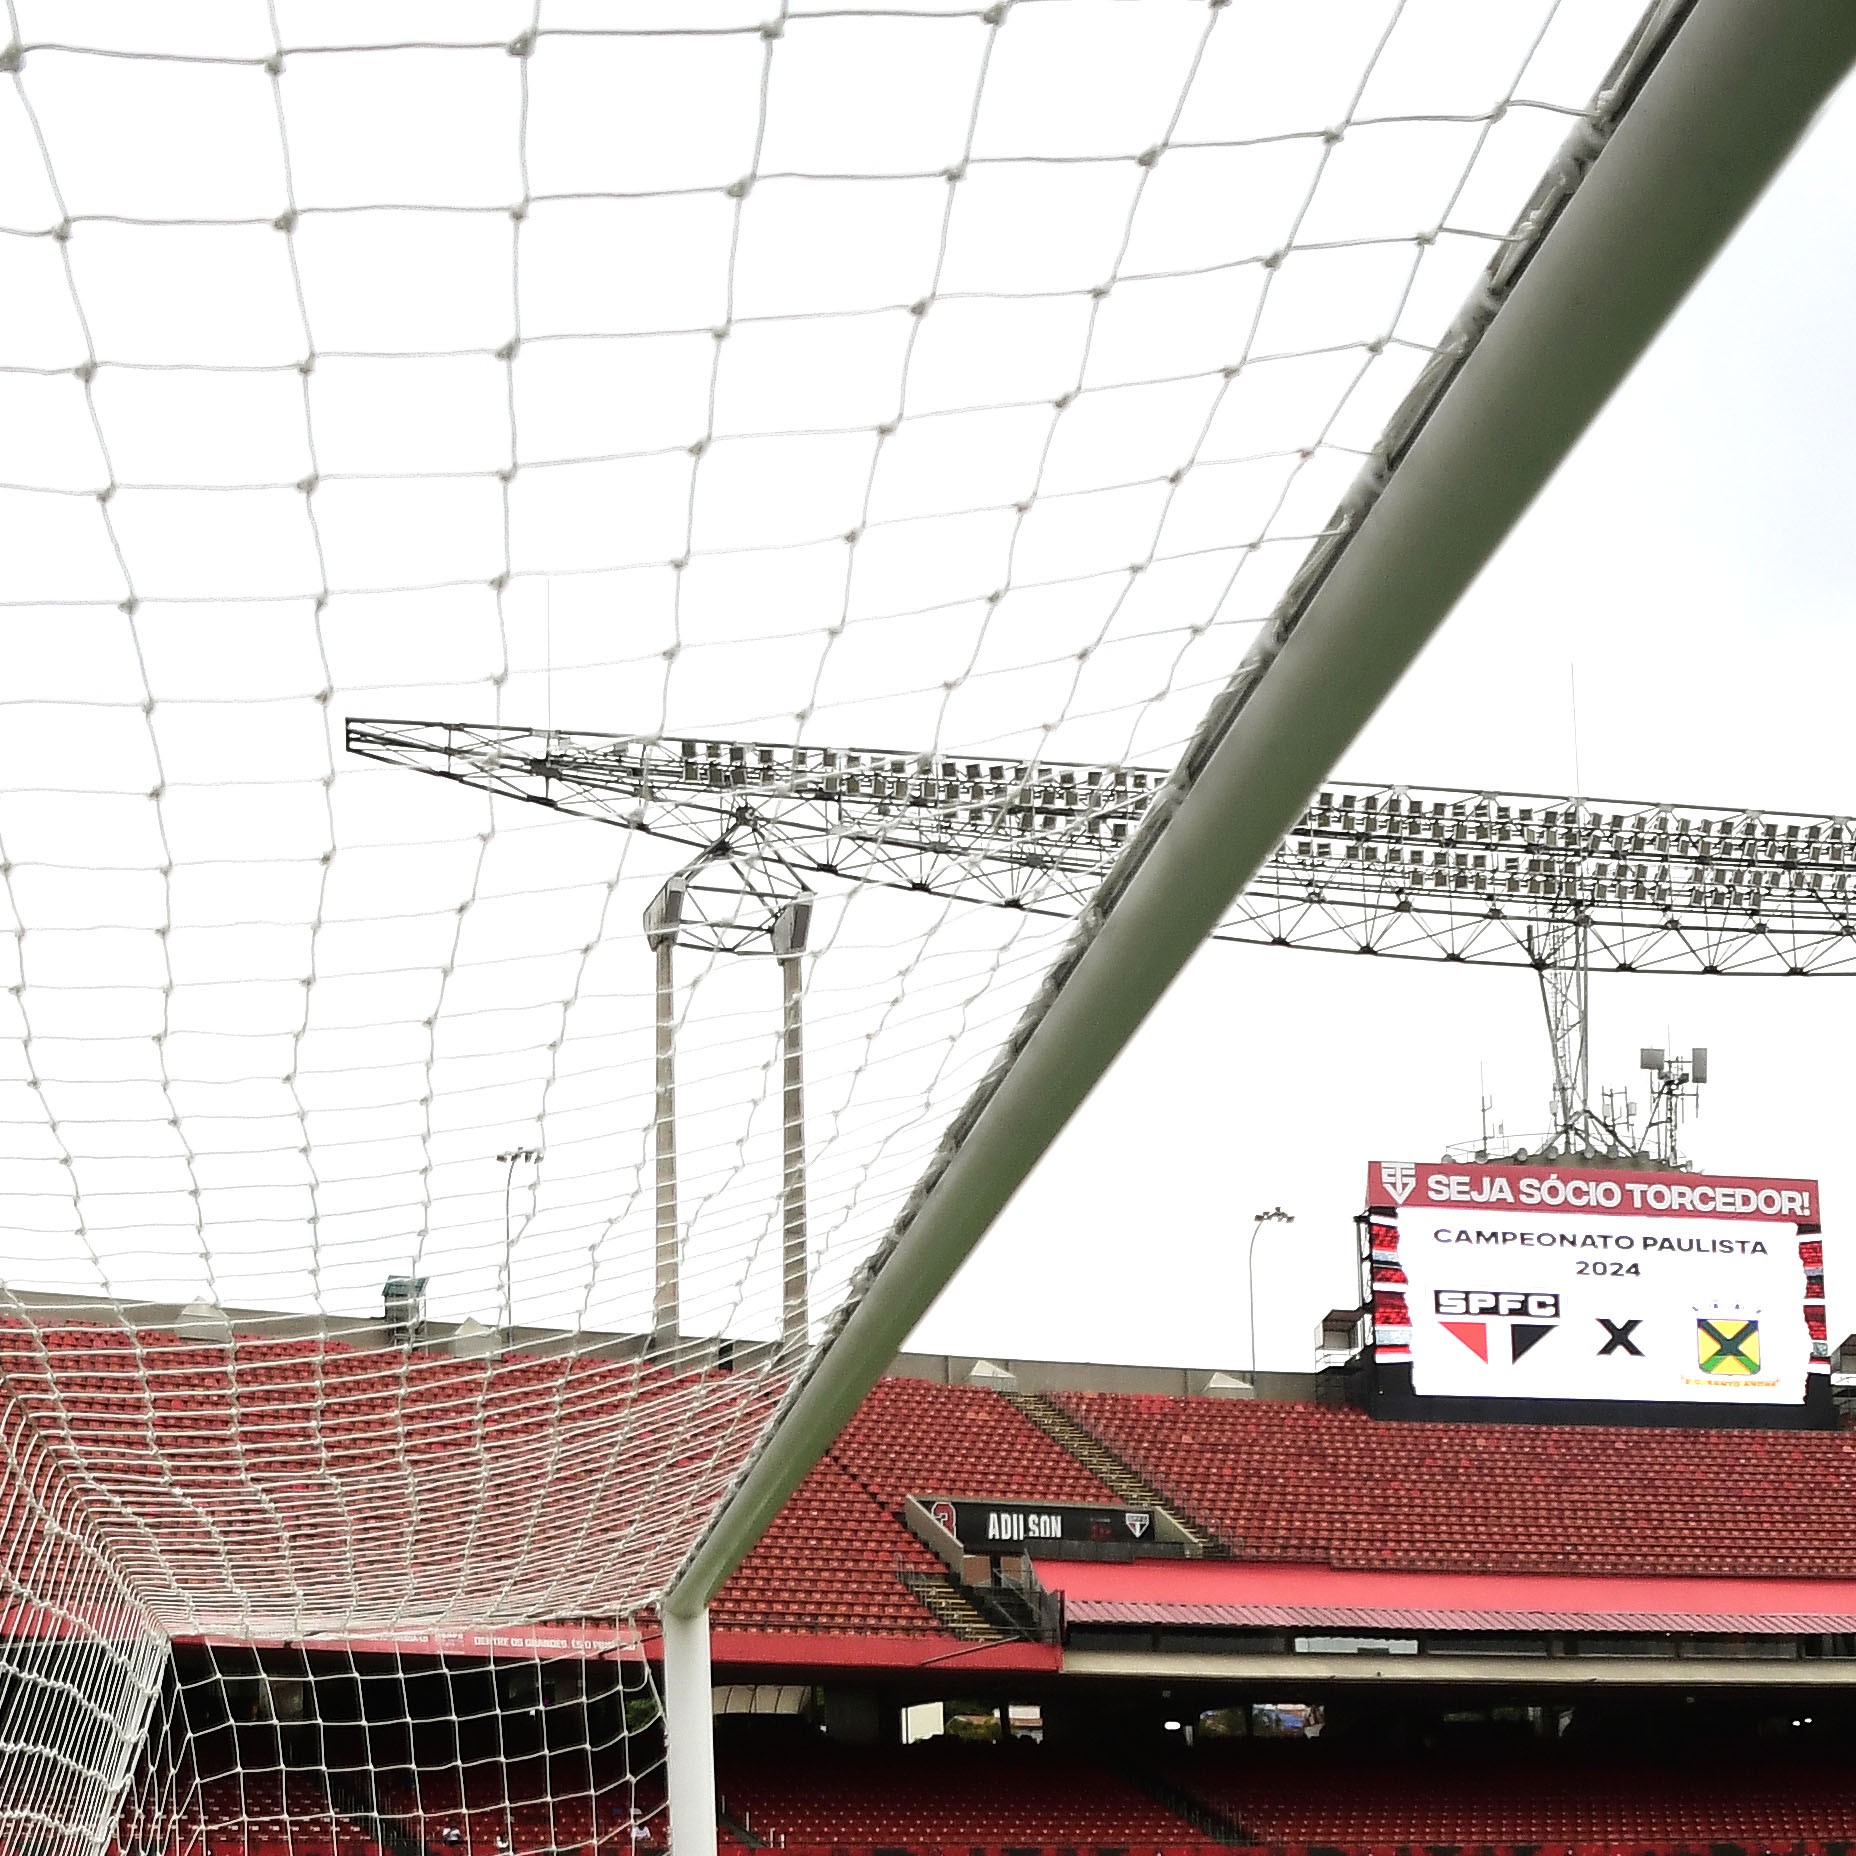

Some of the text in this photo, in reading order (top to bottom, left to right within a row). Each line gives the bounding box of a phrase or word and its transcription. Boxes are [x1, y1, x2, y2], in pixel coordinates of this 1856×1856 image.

[1427, 1174, 1810, 1217] SEJA SÓCIO TORCEDOR!
[1434, 1228, 1769, 1256] CAMPEONATO PAULISTA
[1576, 1261, 1642, 1277] 2024
[1438, 1291, 1556, 1317] SPFC
